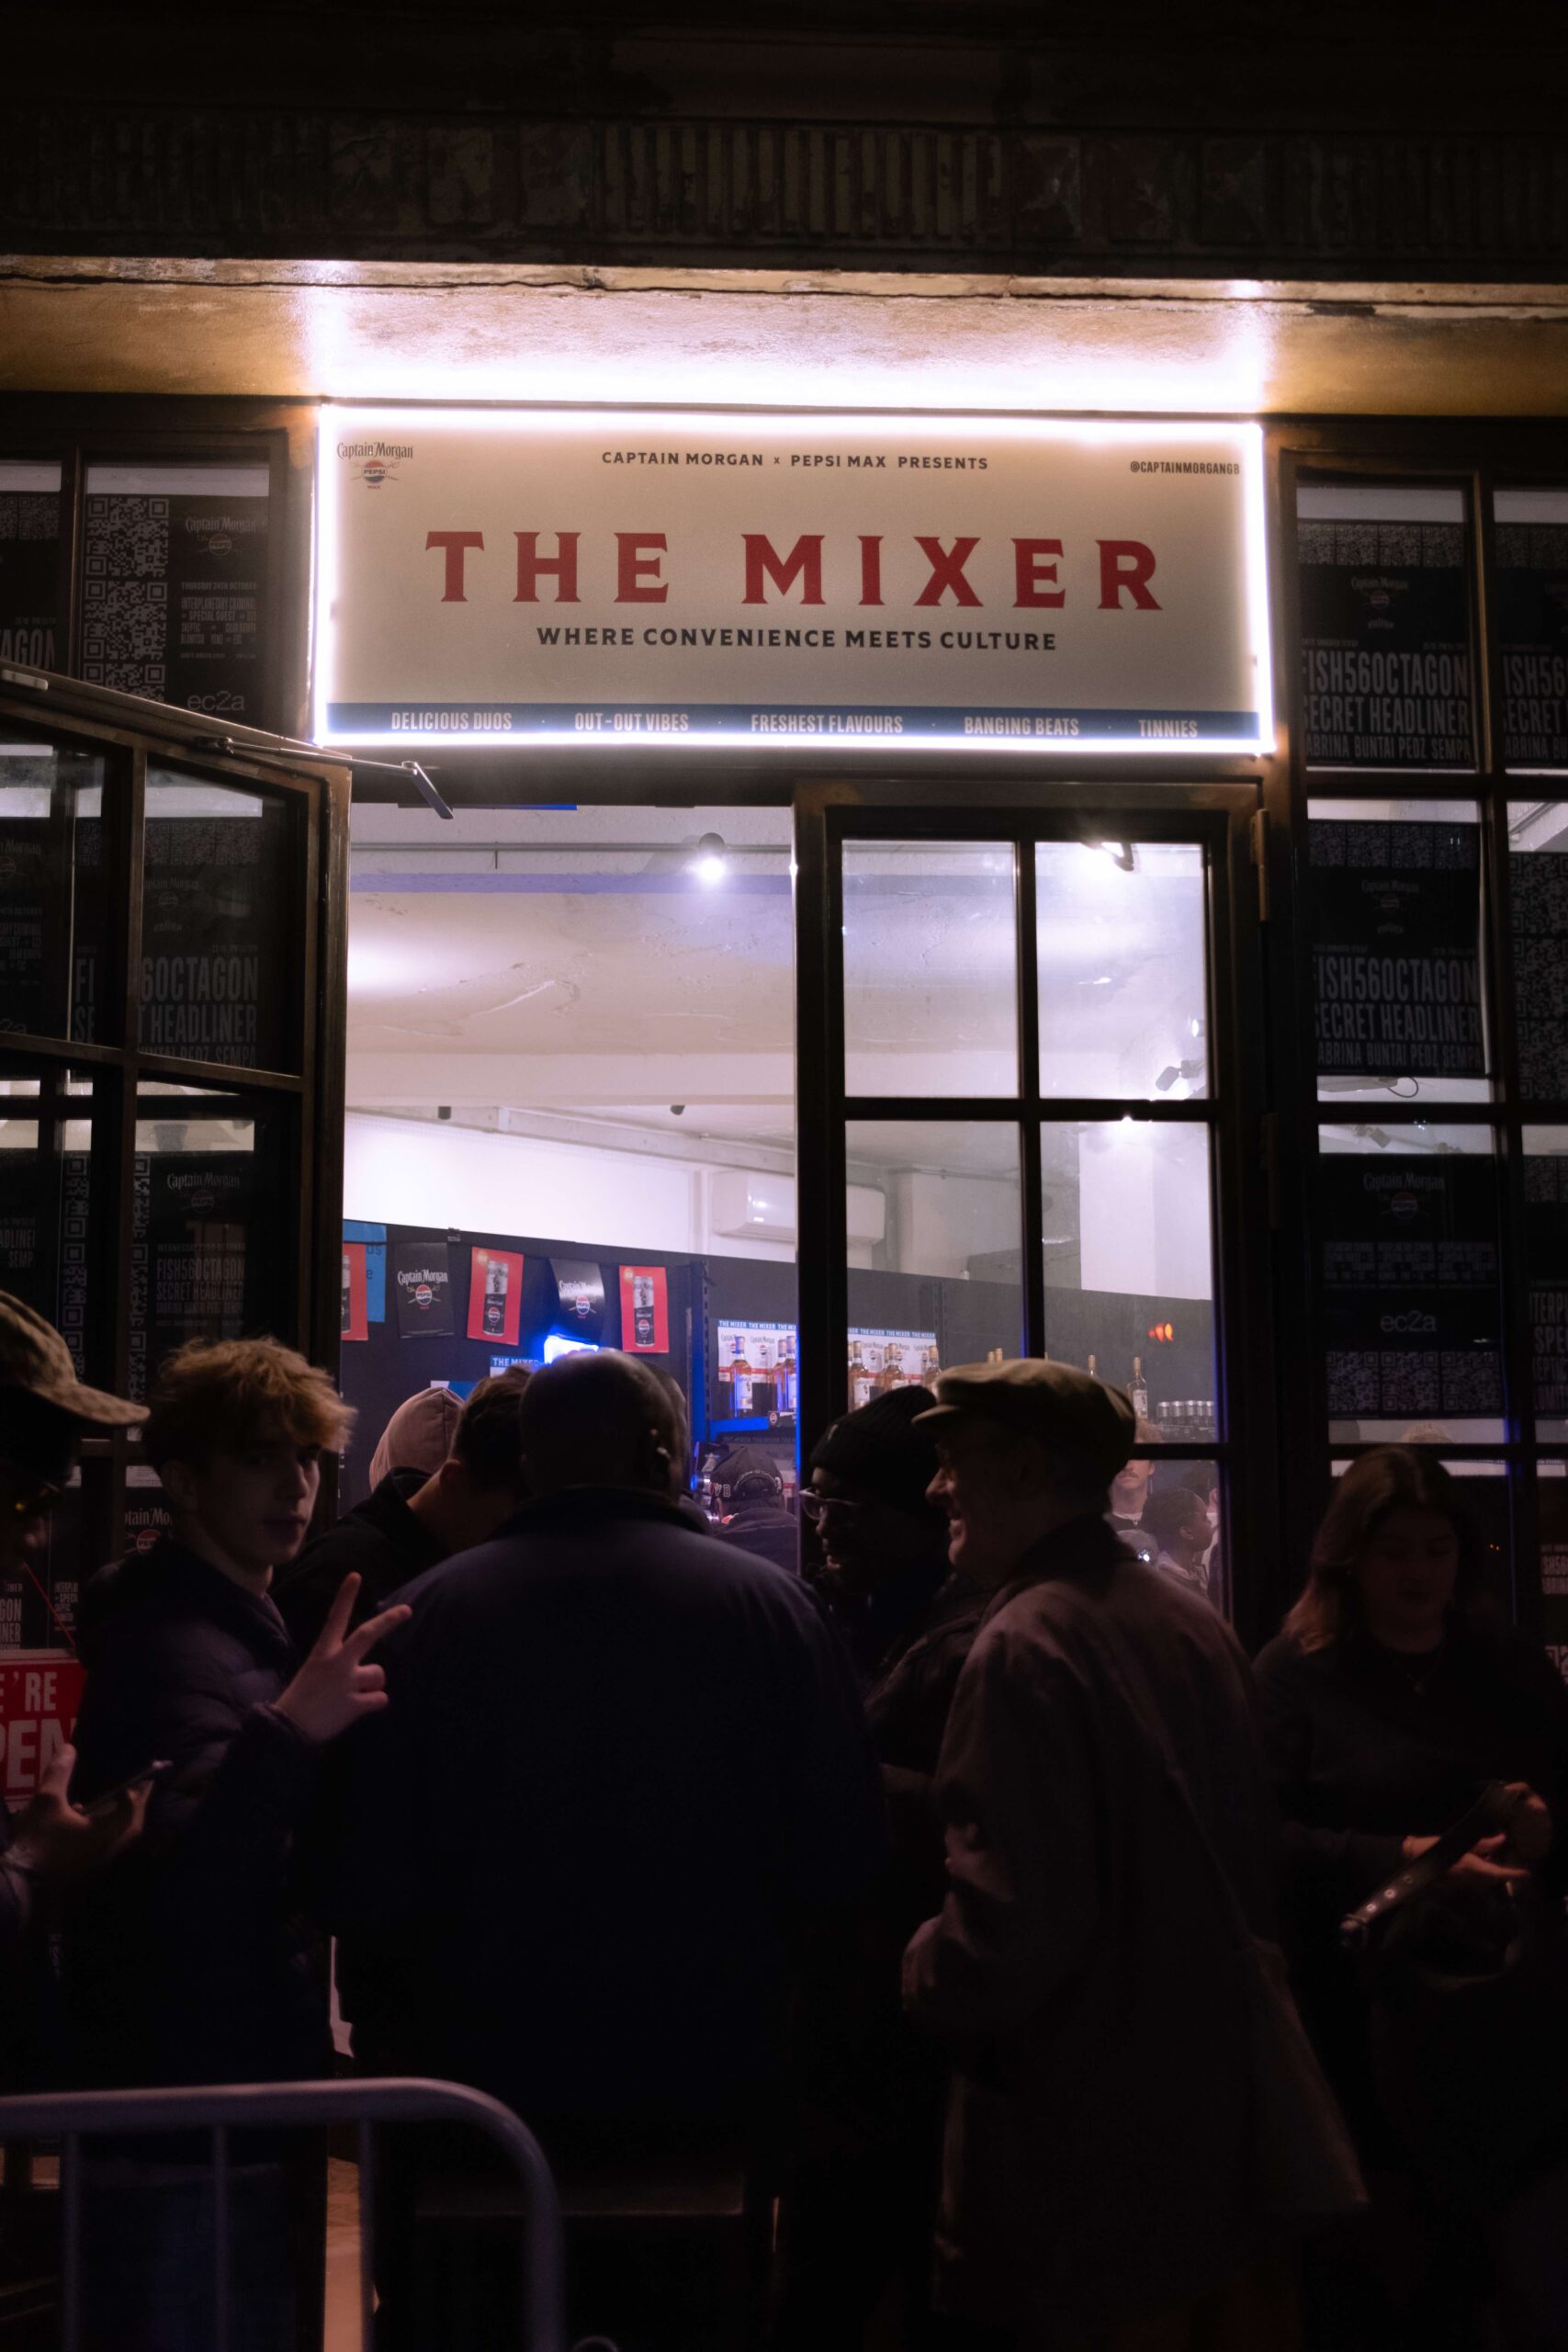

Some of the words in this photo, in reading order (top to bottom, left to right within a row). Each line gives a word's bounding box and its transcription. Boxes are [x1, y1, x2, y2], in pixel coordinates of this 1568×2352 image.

[336, 442, 373, 459] Captain
[374, 442, 412, 459] Morgan
[602, 452, 679, 465] CAPTAIN
[686, 453, 763, 466] MORGAN
[791, 455, 840, 467] PEPSI
[847, 456, 886, 468] MAX
[897, 457, 987, 469] PRESENTS
[1130, 461, 1240, 475] @CAPTAINMORGANGB
[425, 531, 669, 604] THE
[740, 534, 1163, 611] MIXER
[536, 628, 634, 646] WHERE
[642, 628, 835, 648] CONVENIENCE
[845, 630, 931, 649] MEETS
[940, 631, 1056, 650] CULTURE
[187, 690, 245, 711] ec2a
[390, 713, 468, 730] DELICIOUS
[473, 713, 513, 730] DUOS
[646, 714, 689, 731] VIBES
[750, 715, 824, 733] FRESHEST
[829, 716, 904, 734] FLAVOURS
[964, 717, 1031, 735] BANGING
[1035, 718, 1079, 736] BEATS
[1370, 697, 1470, 735] HEADLINER
[1138, 719, 1198, 738] TINNIES
[1306, 733, 1349, 758] ABRINA
[151, 1003, 257, 1044] HEADLINER
[1381, 1003, 1480, 1042] HEADLINER
[1317, 1040, 1360, 1065] ABRINA
[166, 1173, 204, 1192] Captain
[204, 1171, 240, 1190] Morgan
[1363, 1171, 1403, 1193] Captain
[1403, 1171, 1445, 1192] Morgan
[398, 1271, 422, 1285] Captain
[422, 1269, 448, 1283] Morgan
[1381, 1310, 1438, 1332] ec2a
[492, 1357, 509, 1367] THE
